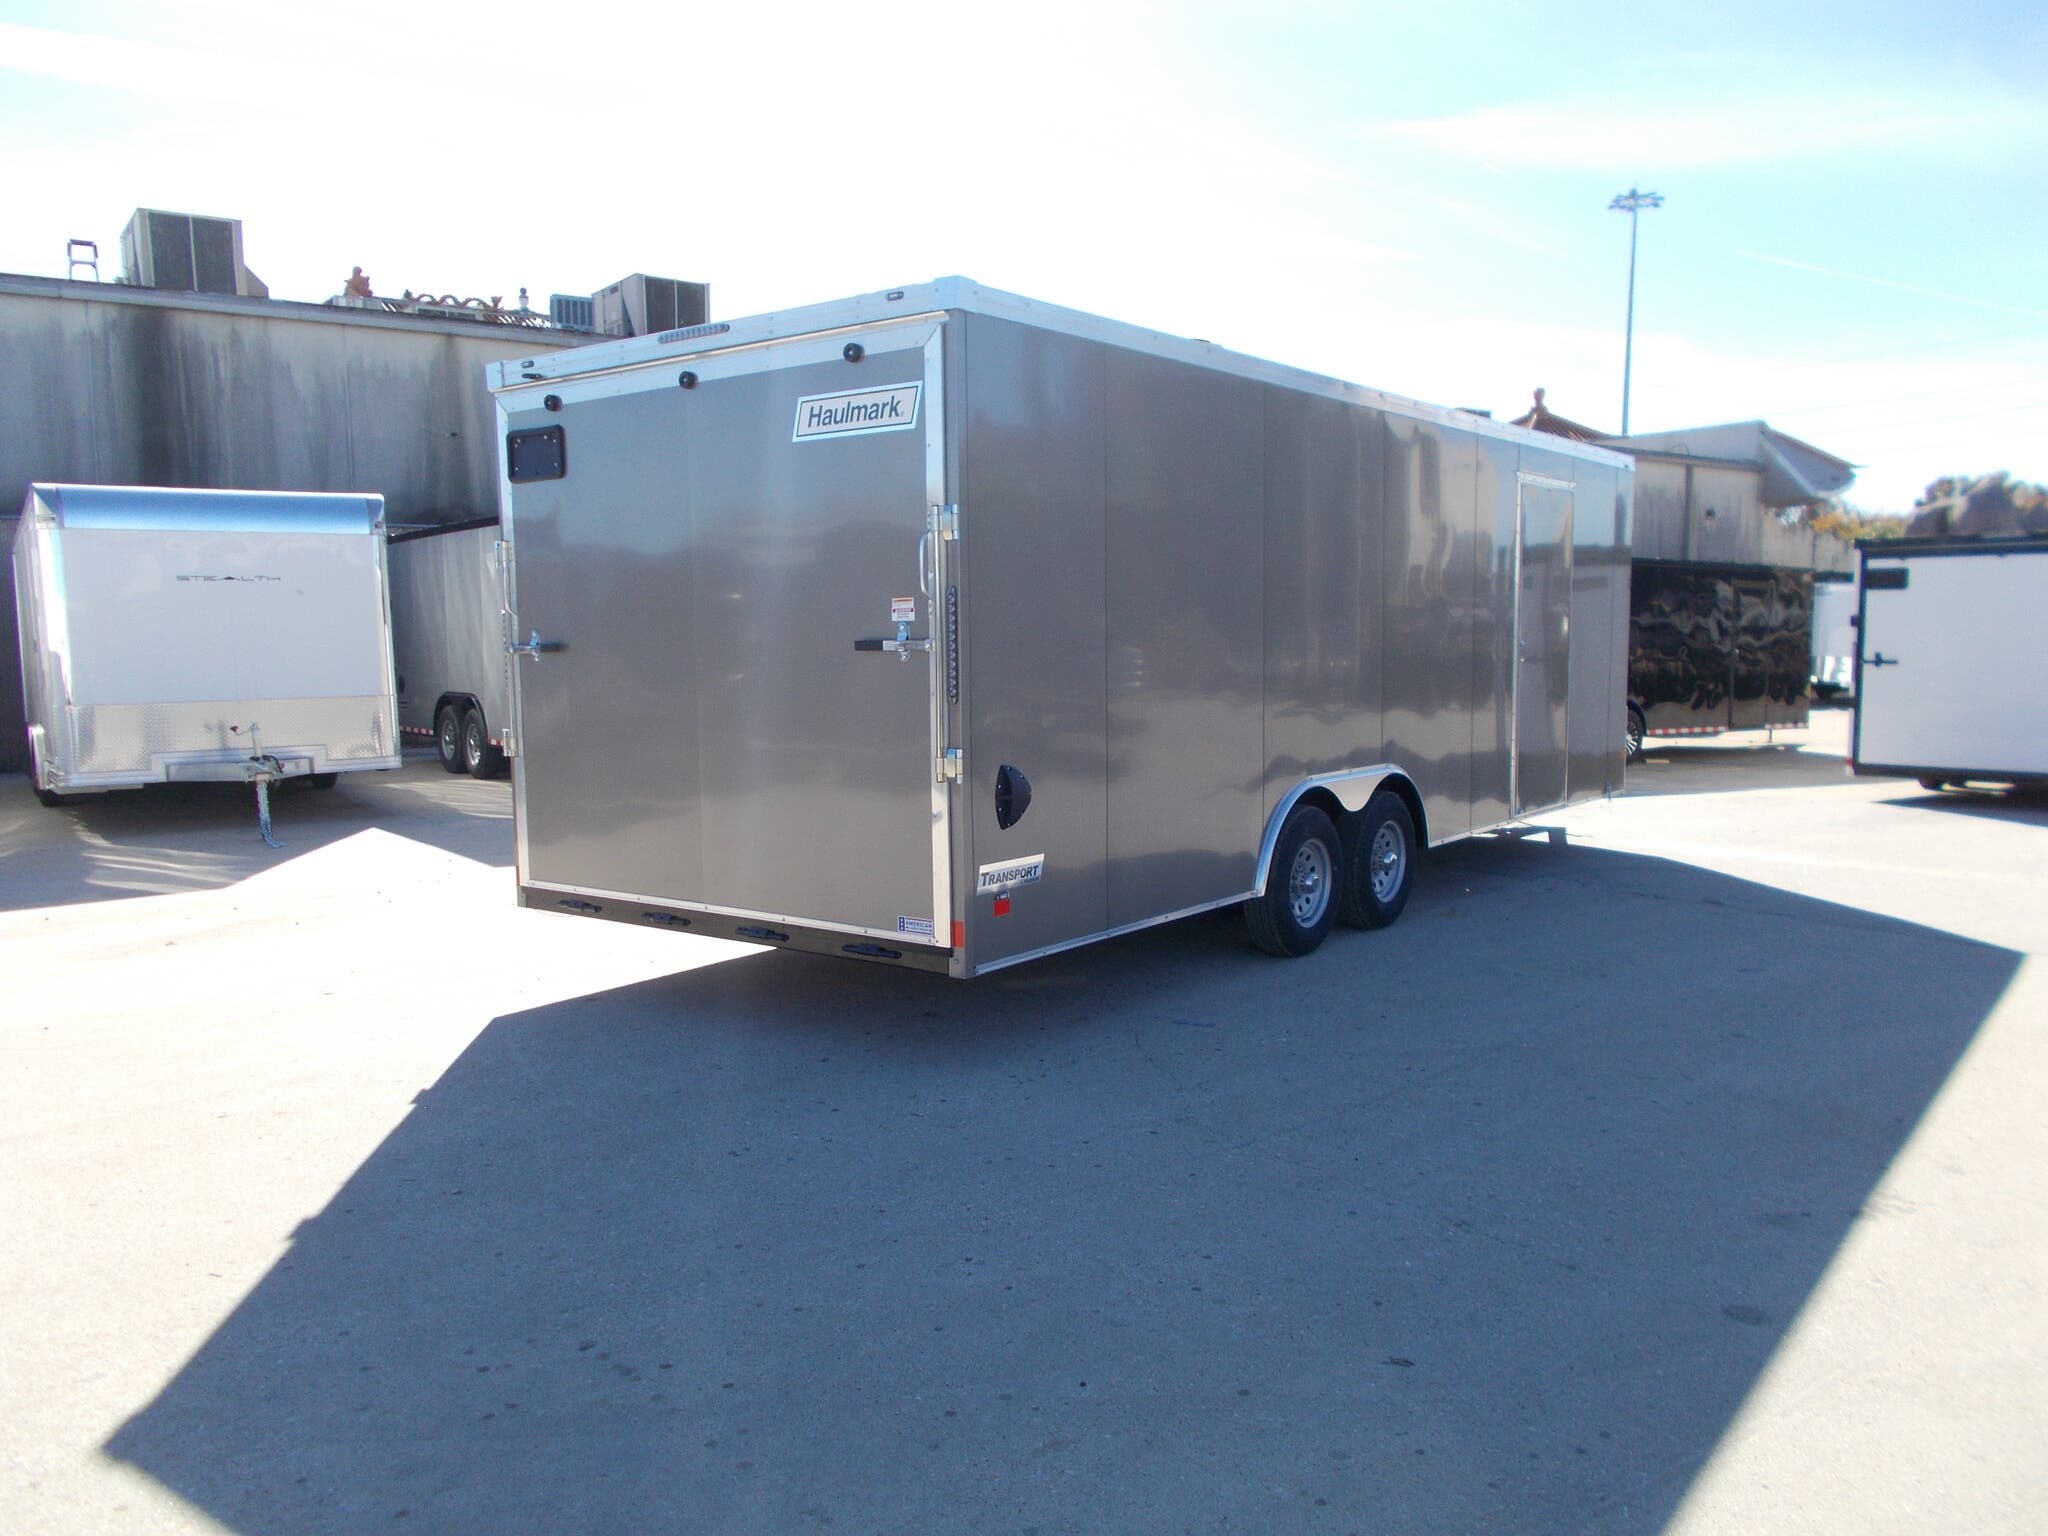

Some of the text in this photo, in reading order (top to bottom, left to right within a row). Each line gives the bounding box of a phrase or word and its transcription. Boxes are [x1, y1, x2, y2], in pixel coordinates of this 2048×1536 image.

[808, 395, 902, 428] Haulmark
[981, 865, 1039, 887] TRANSPORT
[905, 920, 933, 929] AMERICAN
